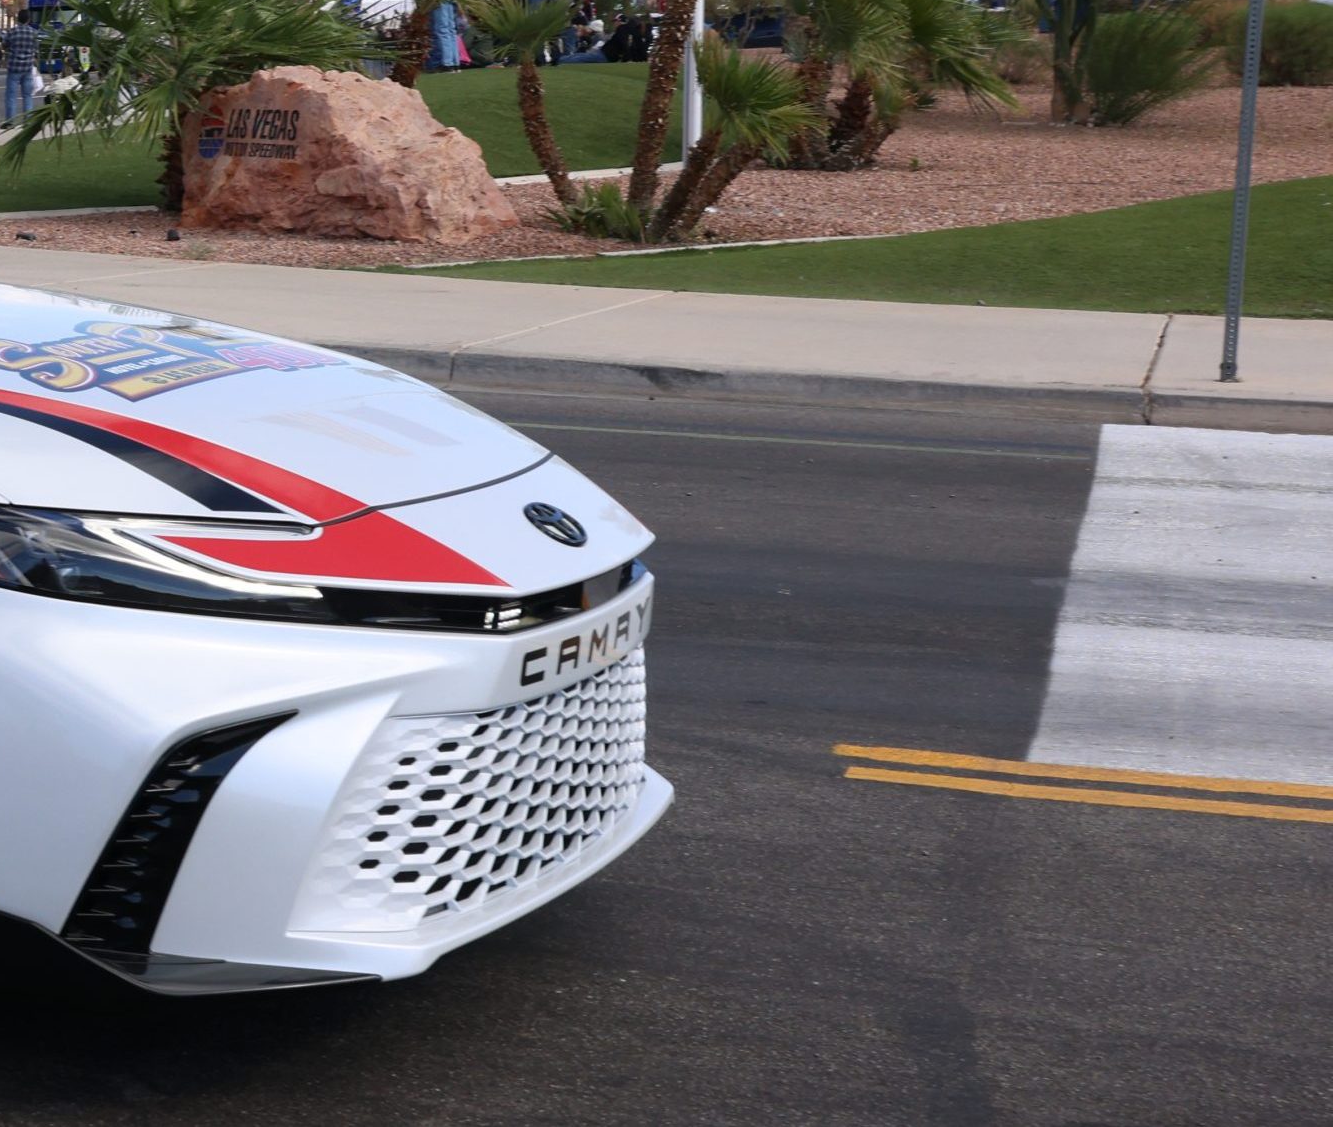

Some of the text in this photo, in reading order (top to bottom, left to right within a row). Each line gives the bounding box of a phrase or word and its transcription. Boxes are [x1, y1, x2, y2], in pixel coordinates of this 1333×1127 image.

[227, 108, 300, 141] LAS VEGAS
[520, 596, 651, 686] CAMRY
